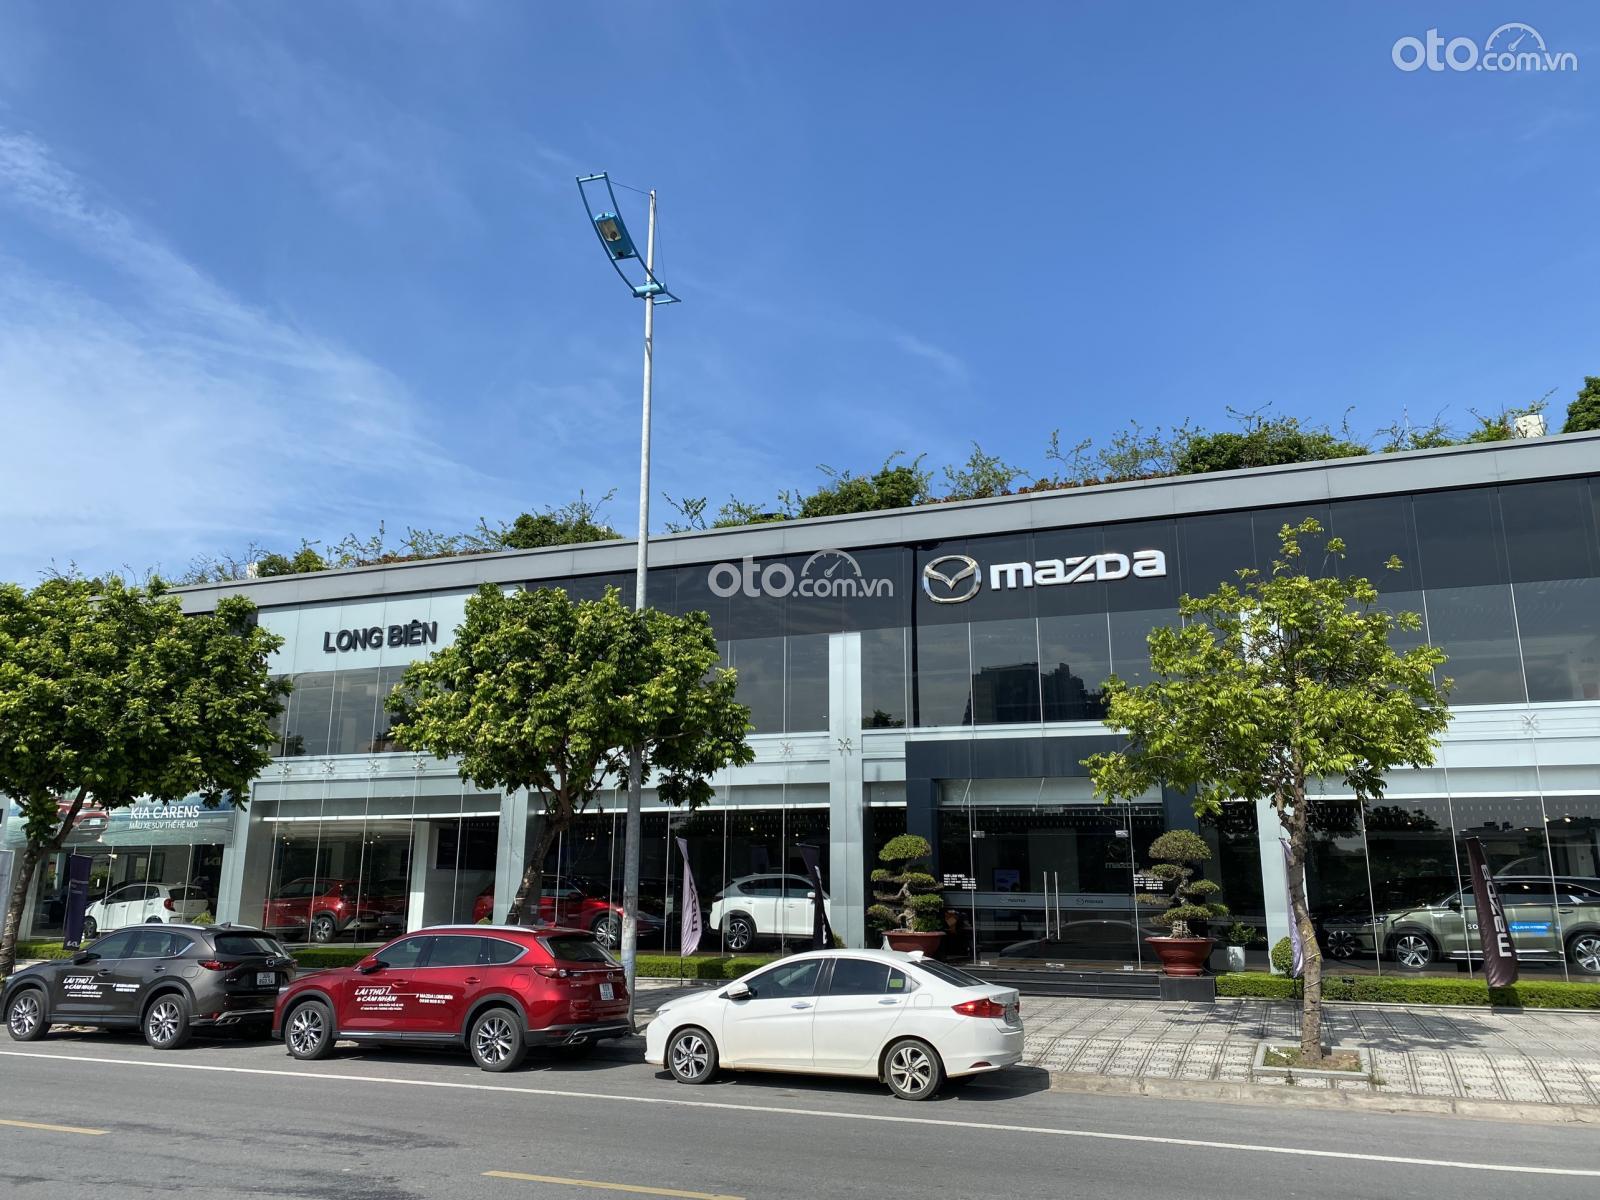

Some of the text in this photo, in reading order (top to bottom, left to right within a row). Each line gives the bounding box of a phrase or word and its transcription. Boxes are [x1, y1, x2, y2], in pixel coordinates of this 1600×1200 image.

[322, 619, 438, 653] LONG BIÊN
[130, 805, 200, 820] KIA CARENS
[152, 821, 164, 830] SUV
[1481, 864, 1512, 957] mazda
